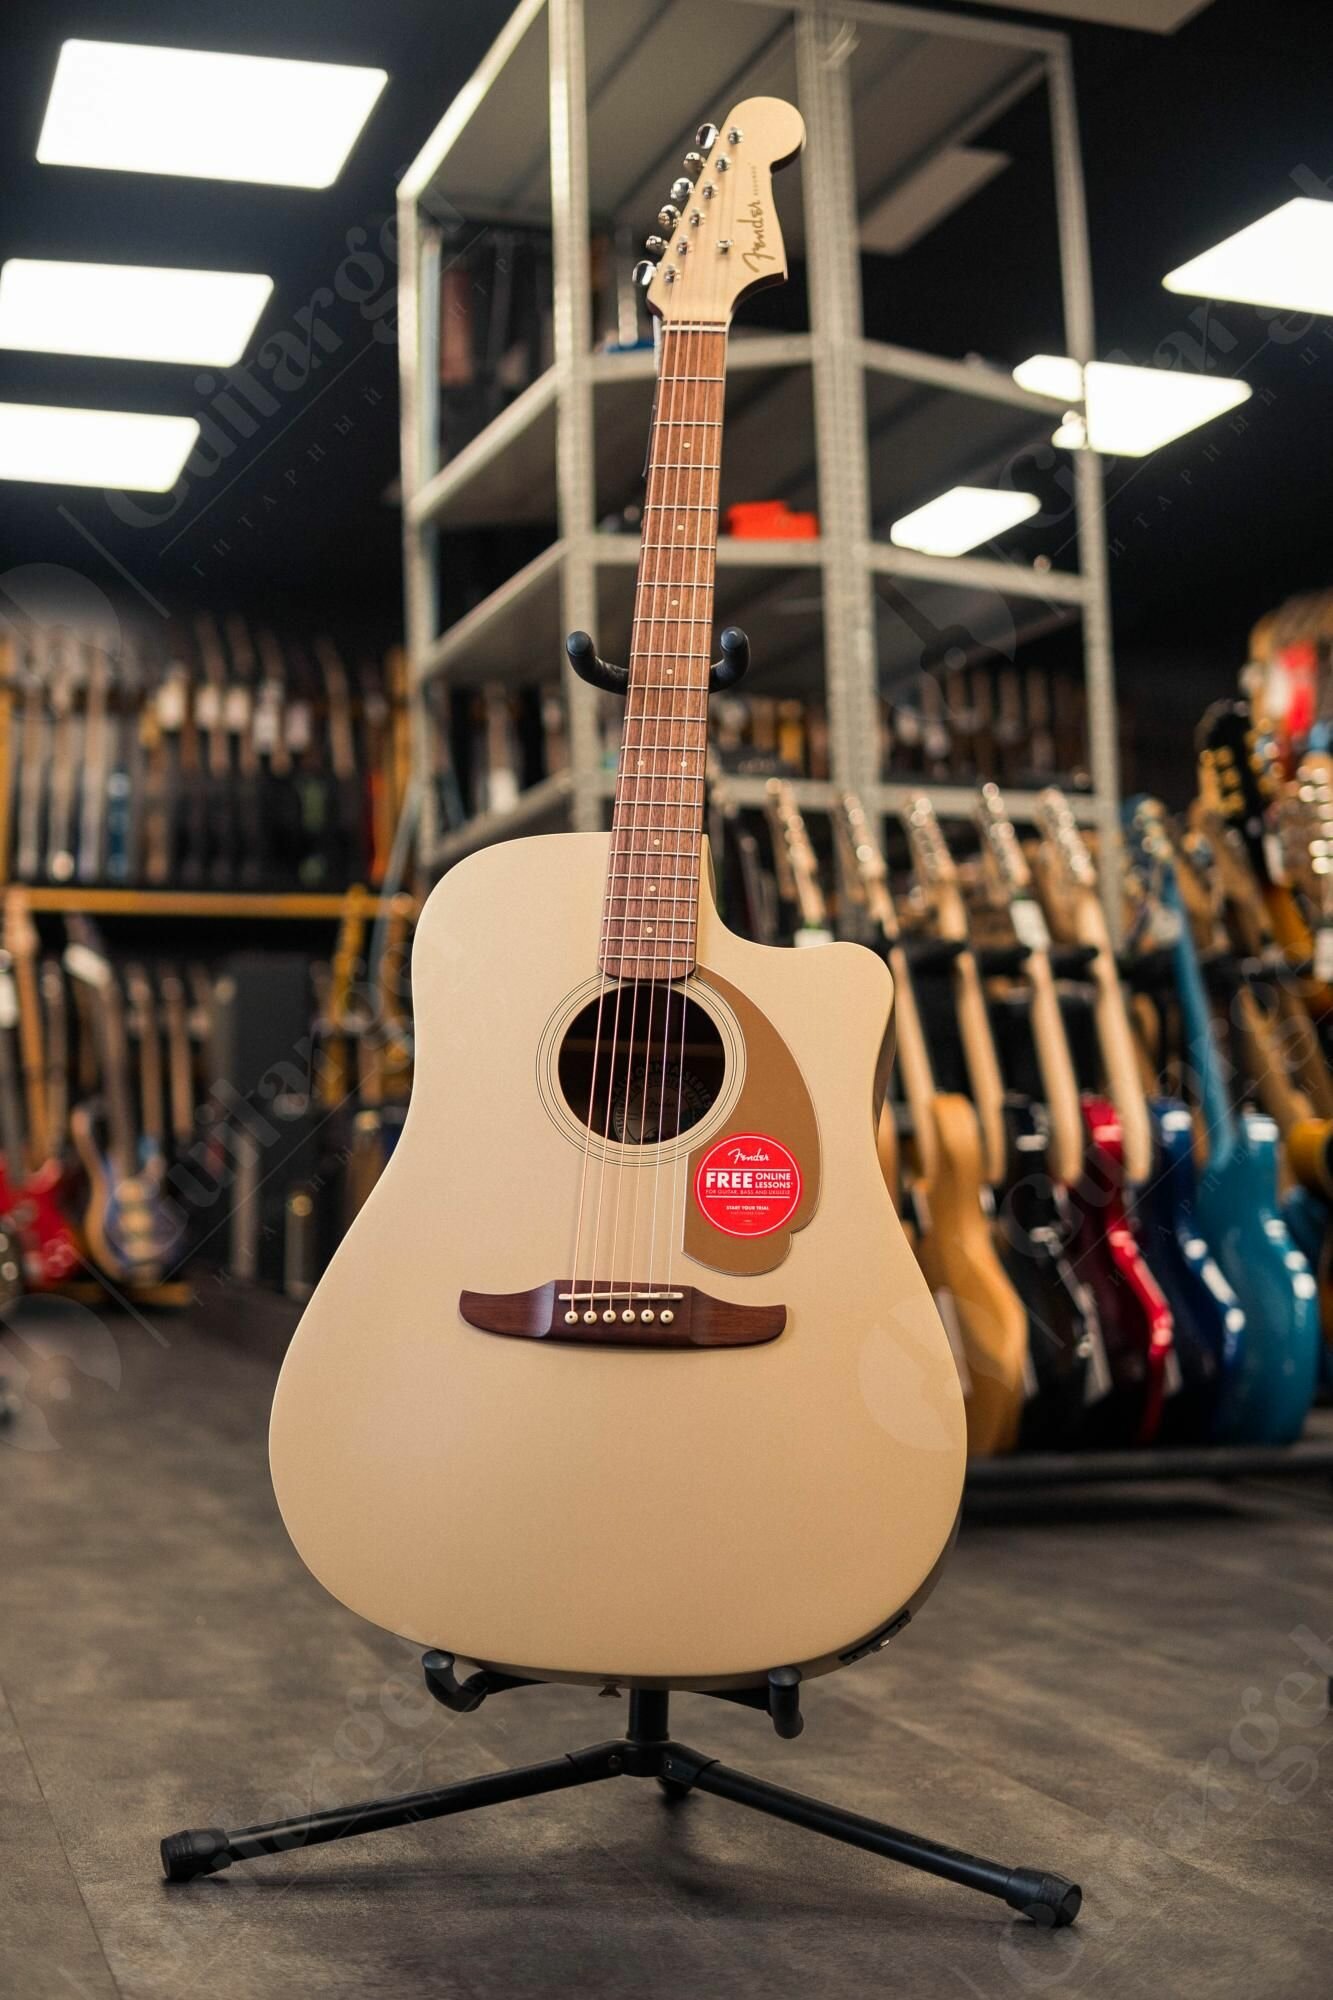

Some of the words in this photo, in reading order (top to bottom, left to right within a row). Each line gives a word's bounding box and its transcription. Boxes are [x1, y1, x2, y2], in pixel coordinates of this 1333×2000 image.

[737, 199, 775, 273] Fender
[727, 1147, 769, 1165] Fender
[705, 1172, 753, 1189] FREE
[755, 1172, 791, 1181] ONLINE
